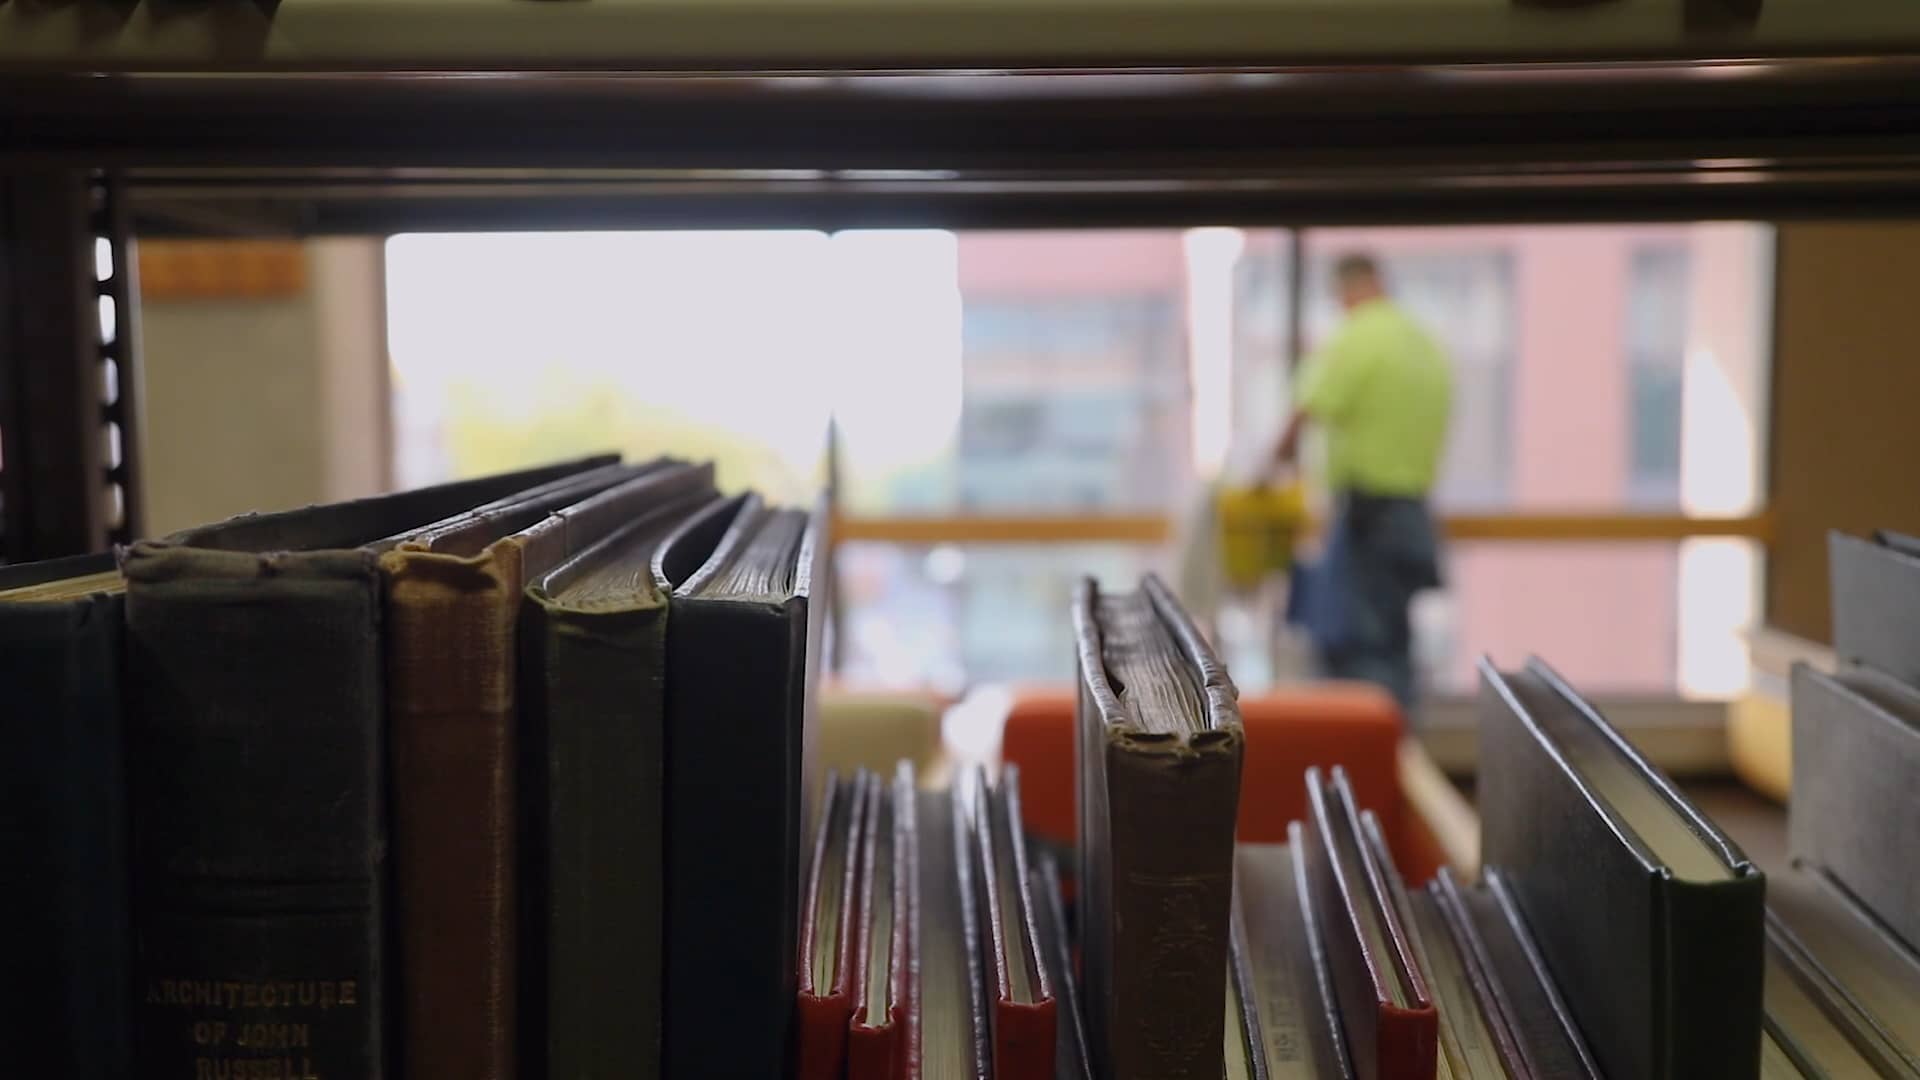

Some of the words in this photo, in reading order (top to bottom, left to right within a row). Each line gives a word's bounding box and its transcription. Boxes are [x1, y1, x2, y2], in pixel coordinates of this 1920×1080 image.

[145, 979, 357, 1007] ARCHITECTURE
[193, 1022, 227, 1046] OF
[236, 1023, 309, 1047] JOHN
[196, 1056, 319, 1080] RUSSELL
